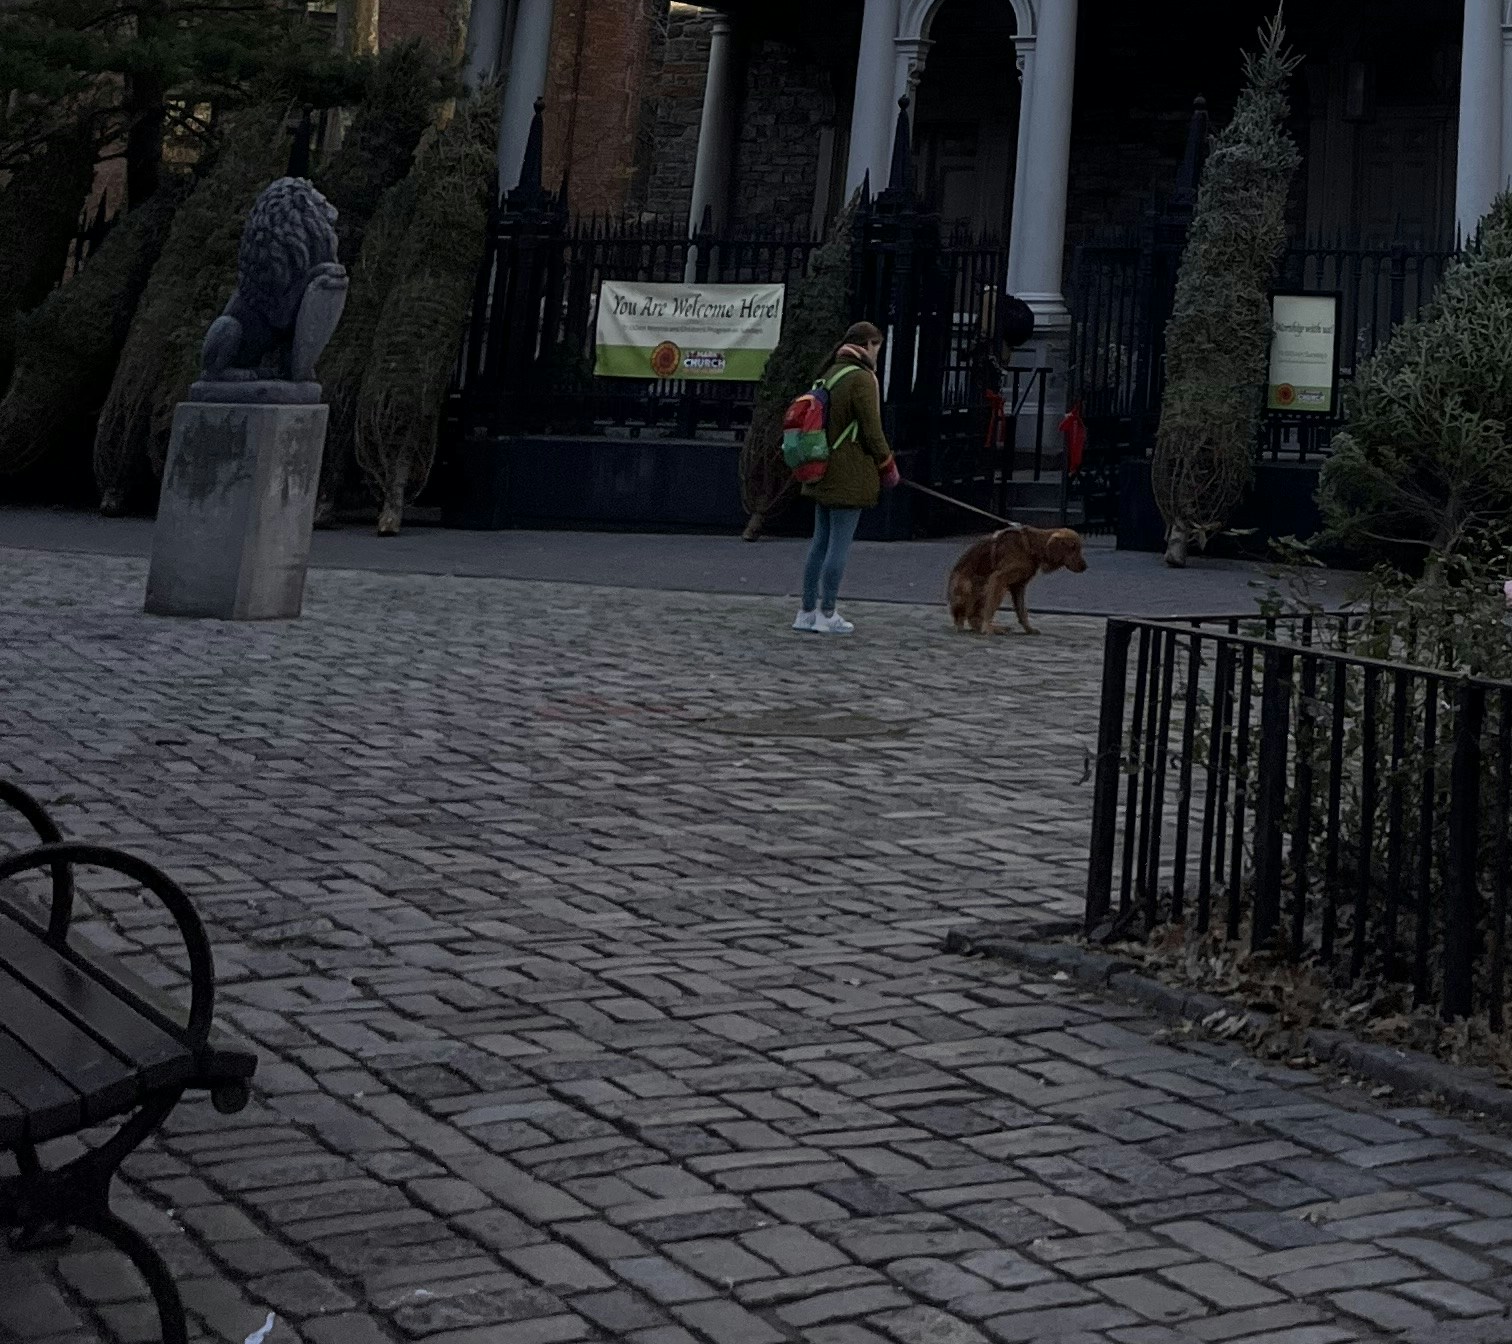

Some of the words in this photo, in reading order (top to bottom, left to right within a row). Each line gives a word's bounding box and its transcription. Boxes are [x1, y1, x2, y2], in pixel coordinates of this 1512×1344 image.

[613, 294, 637, 316] You
[640, 297, 667, 317] Are
[673, 293, 735, 318] Welcome
[739, 294, 779, 319] Here!
[684, 358, 726, 369] CHURCH
